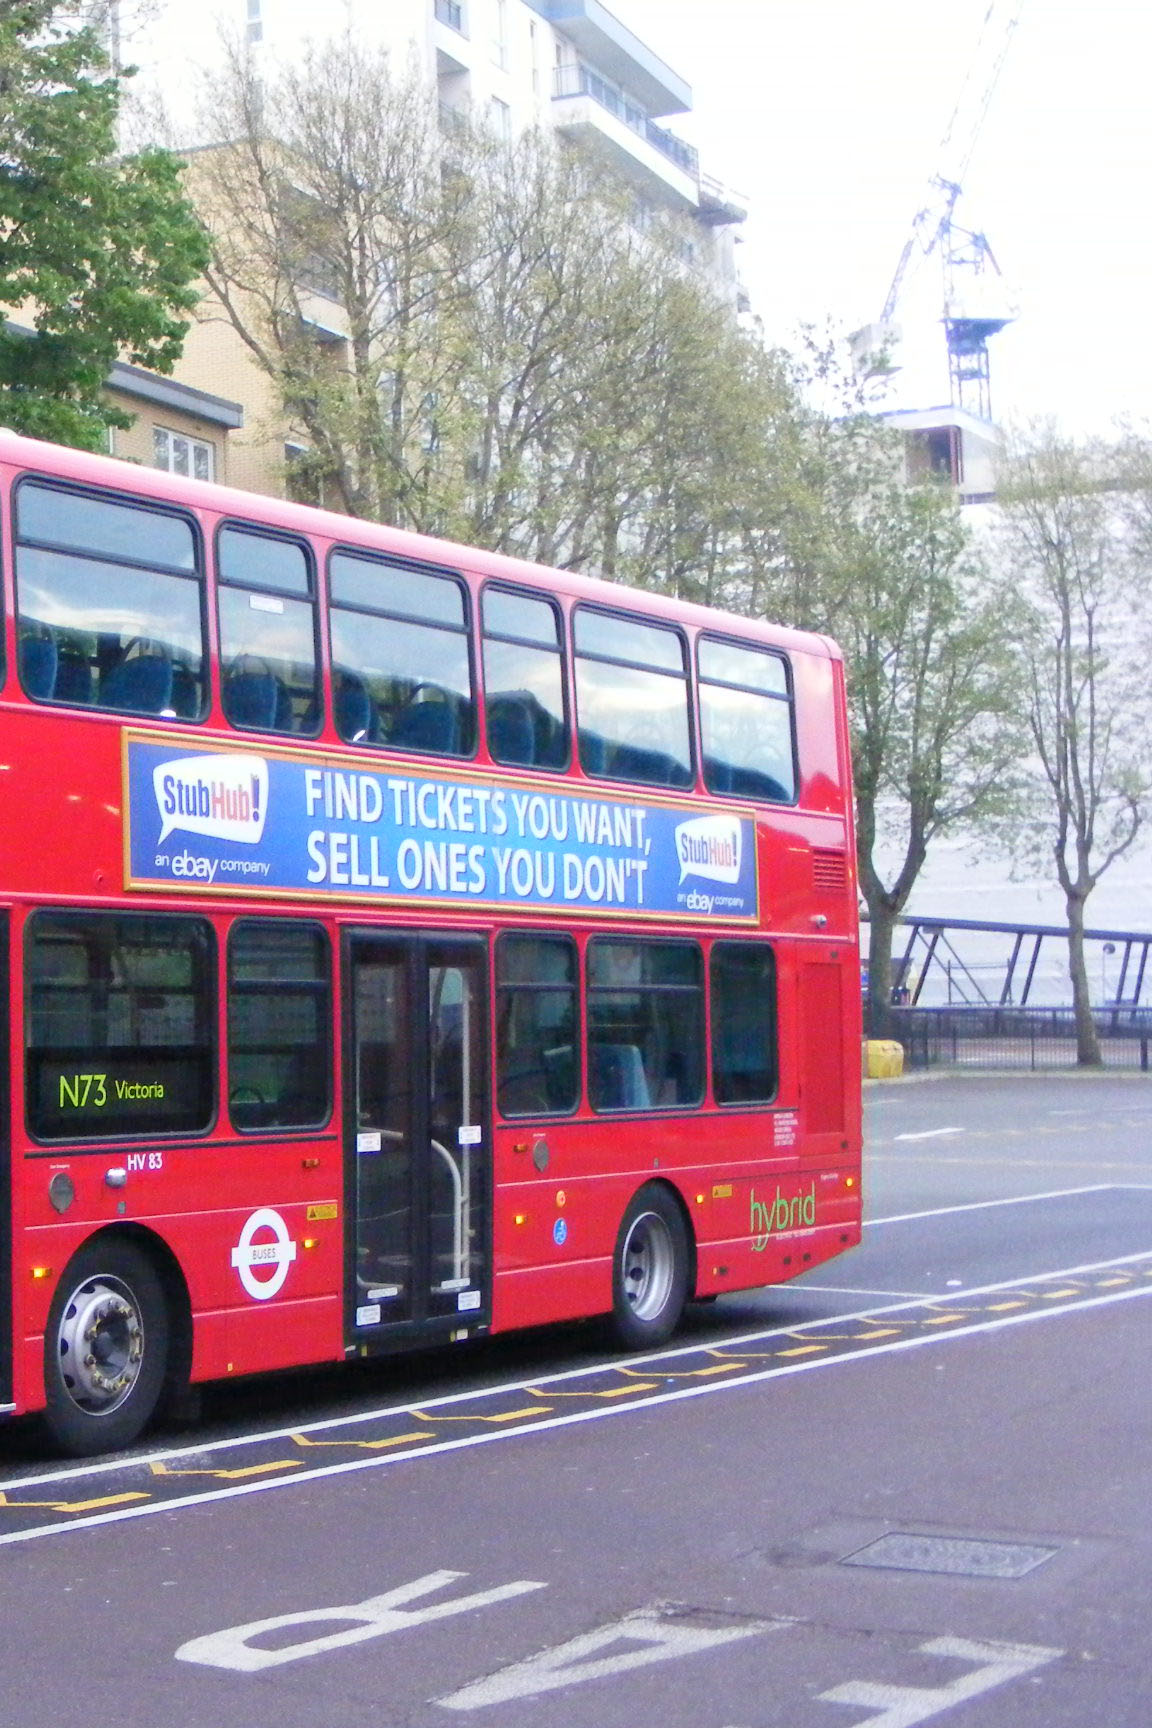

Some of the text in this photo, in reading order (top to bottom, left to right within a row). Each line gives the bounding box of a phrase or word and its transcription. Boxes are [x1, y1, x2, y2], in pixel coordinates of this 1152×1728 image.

[163, 774, 260, 823] StubHub!
[305, 769, 652, 855] FIND TICKETS YOU WANT,
[681, 831, 738, 867] StubHub!
[154, 850, 270, 883] an ebay company
[307, 830, 648, 904] SELL ONES YOU DON'T
[686, 889, 714, 914] ebay
[715, 896, 744, 909] company
[60, 1074, 164, 1107] N73 Victoria
[127, 1152, 163, 1170] HV 83
[750, 1180, 816, 1251] hybrid
[252, 1248, 276, 1260] BUSES
